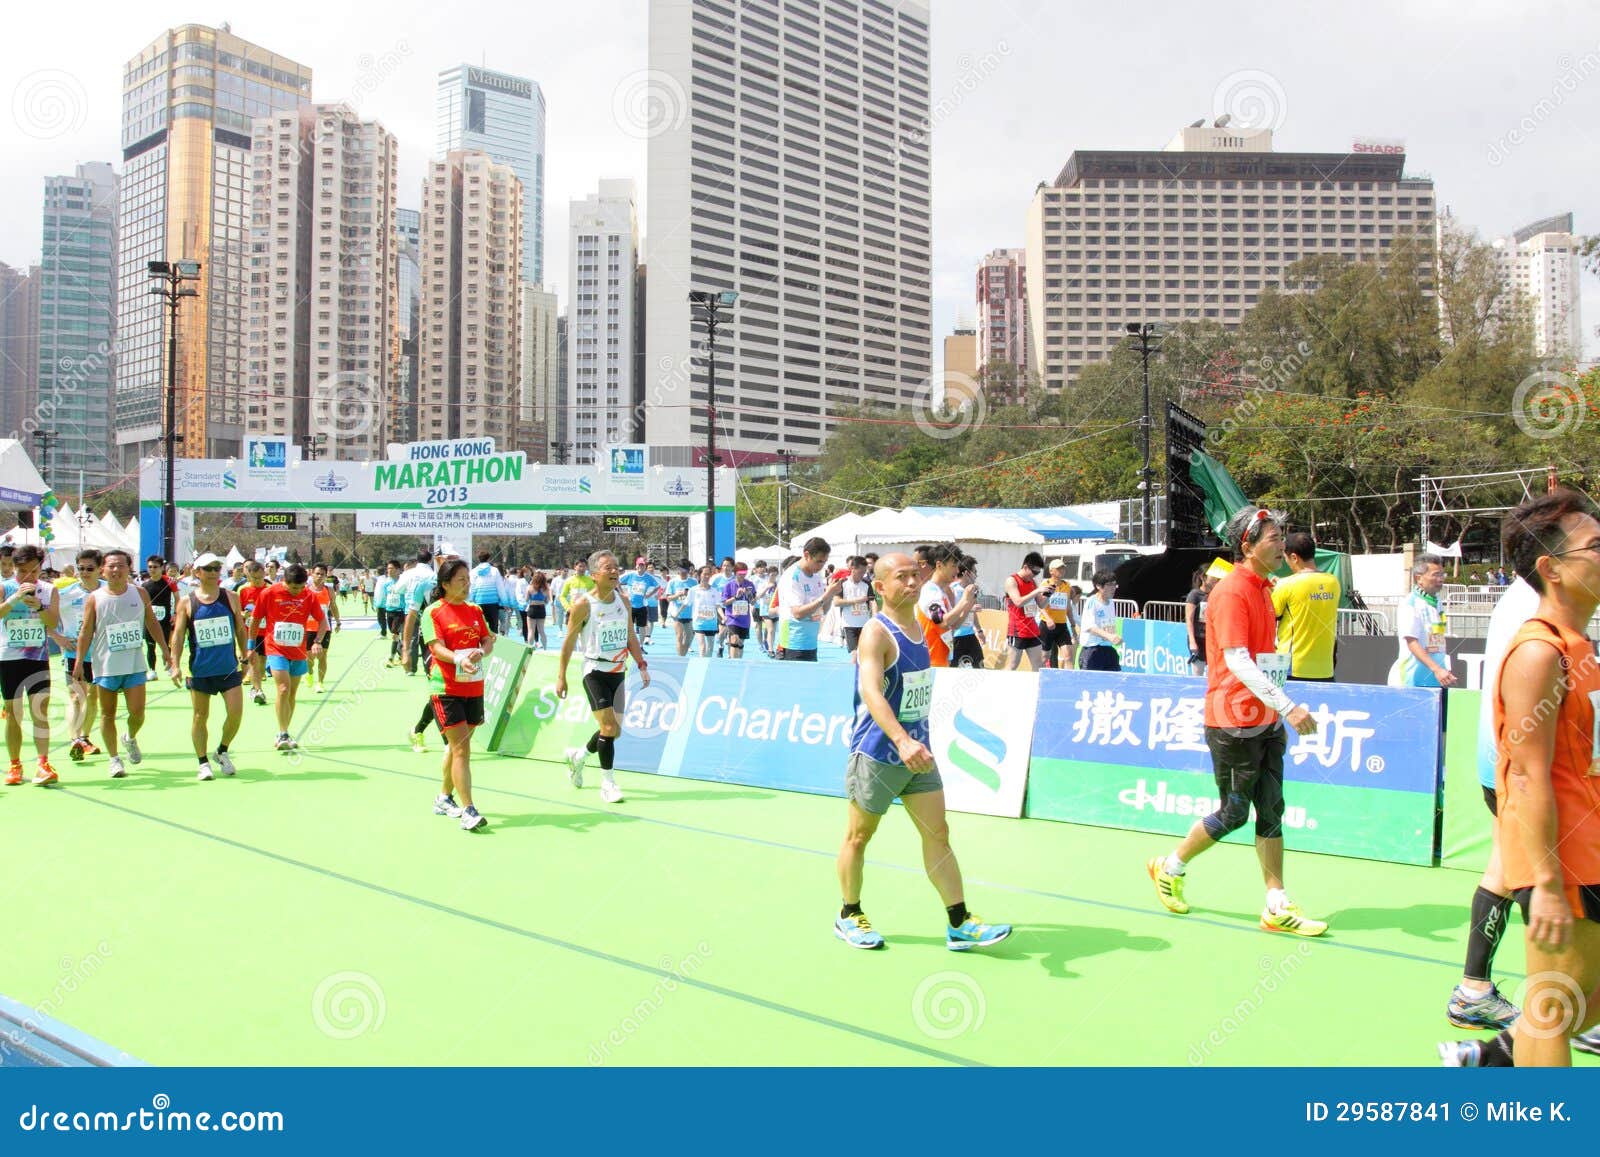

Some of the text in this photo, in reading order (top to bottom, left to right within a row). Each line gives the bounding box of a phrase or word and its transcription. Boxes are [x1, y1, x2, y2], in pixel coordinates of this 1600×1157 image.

[1352, 143, 1405, 154] SHARP
[411, 441, 491, 460] HONG KONG
[184, 472, 221, 480] Standard
[374, 455, 523, 491] MARATHON
[181, 481, 221, 489] Chartered
[544, 477, 577, 485] Standard
[426, 486, 468, 504] 2013
[419, 521, 465, 529] MARATHON
[467, 521, 533, 529] CHAMPIONSHIPS
[10, 628, 43, 641] 23672
[110, 630, 141, 645] 26956
[199, 625, 229, 641] 28149
[276, 630, 301, 641] M1701
[602, 628, 627, 643] 28422
[905, 685, 931, 709] 2805
[533, 685, 688, 730] Staard
